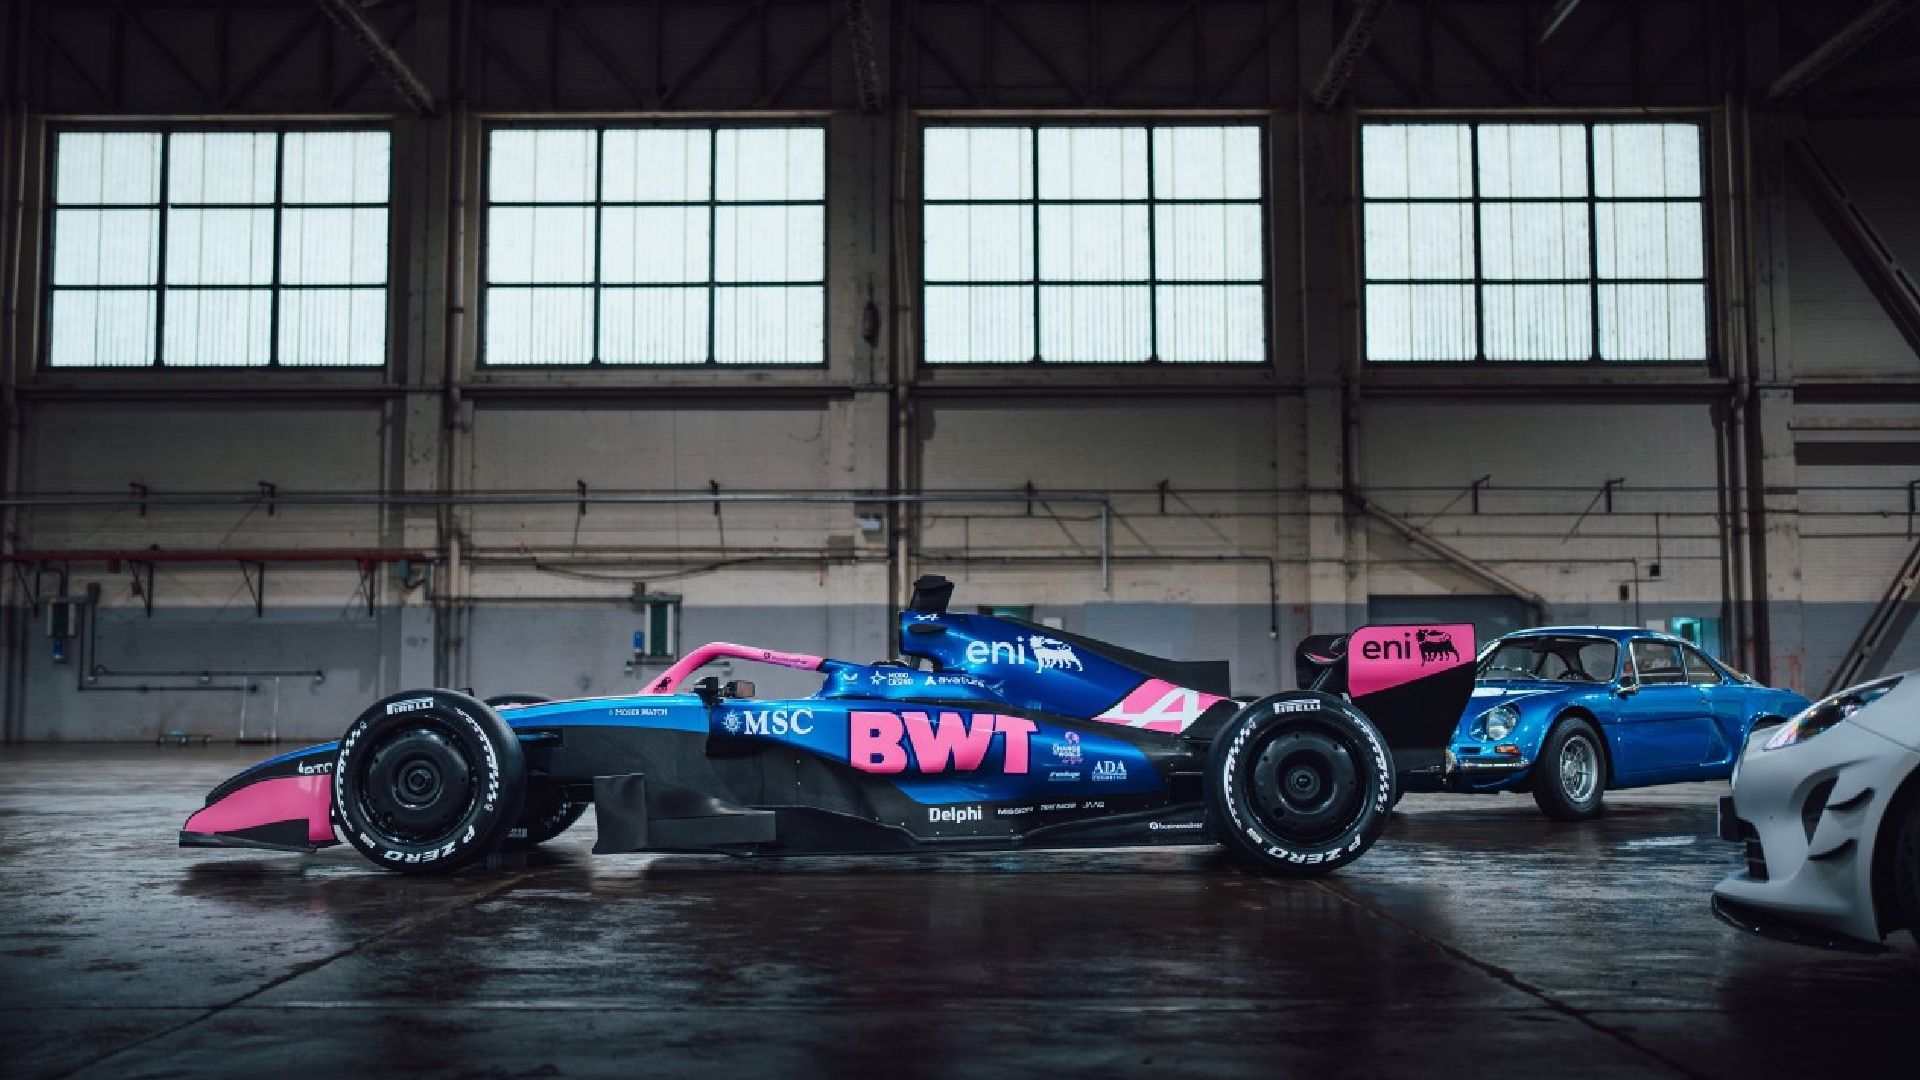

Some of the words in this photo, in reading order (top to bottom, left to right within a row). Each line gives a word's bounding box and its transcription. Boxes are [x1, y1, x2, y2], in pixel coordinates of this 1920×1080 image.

[965, 635, 1025, 665] eni
[1362, 632, 1411, 660] eni
[1272, 698, 1321, 715] PIRELLI
[743, 707, 814, 735] MSC
[850, 711, 1039, 774] BWT
[1094, 760, 1126, 773] ADA
[929, 804, 983, 824] Delphi
[383, 840, 456, 864] ZERO
[1266, 845, 1342, 864] ZERO
